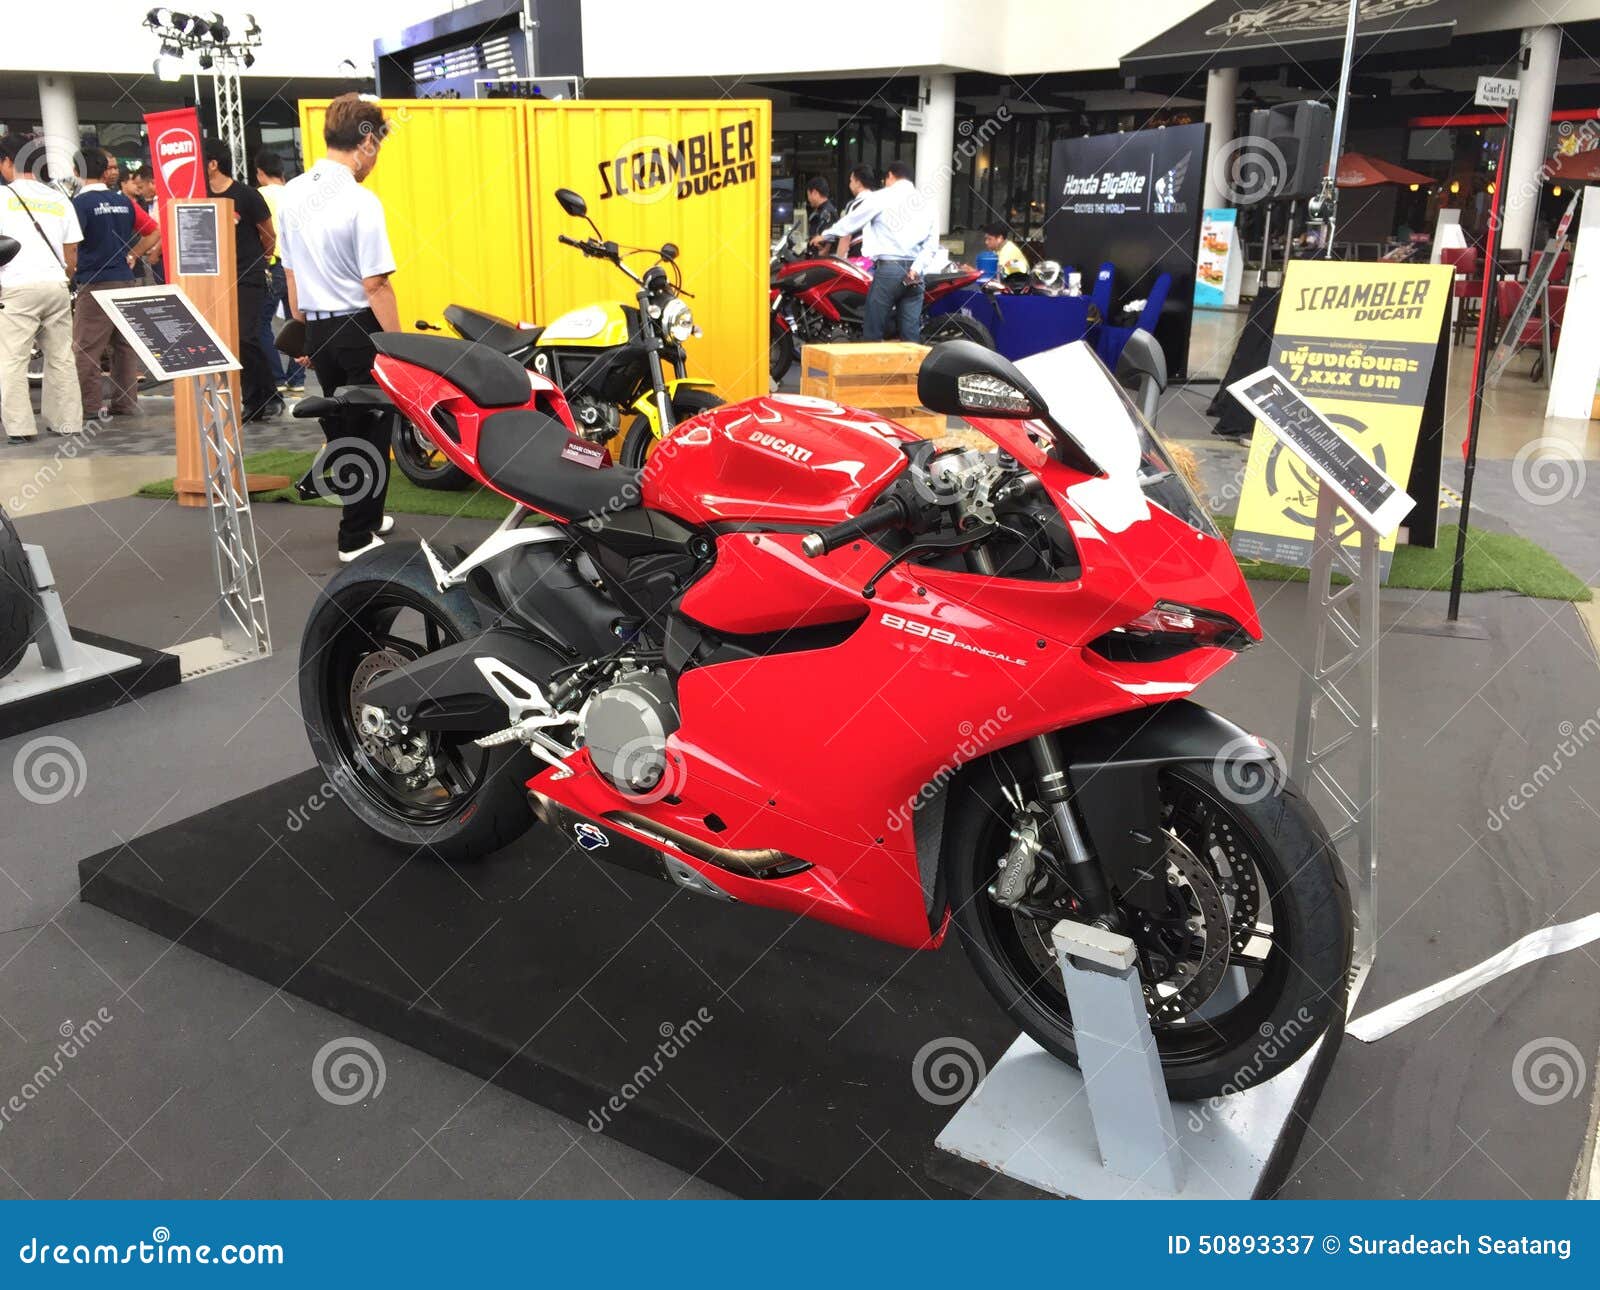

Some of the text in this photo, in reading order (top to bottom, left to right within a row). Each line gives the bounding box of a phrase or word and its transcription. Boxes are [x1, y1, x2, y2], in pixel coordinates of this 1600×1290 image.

[160, 140, 193, 156] DUCATI
[598, 120, 754, 200] SCRAMBLER
[677, 160, 756, 200] DUCATI
[1063, 171, 1146, 200] Honda BigBike
[1296, 279, 1431, 312] SCRAMBLER
[1354, 307, 1423, 322] DUCATI
[1280, 346, 1420, 373] เพียงเดือนละ
[1359, 373, 1402, 390] บาท
[748, 430, 814, 463] DUCATI
[880, 613, 957, 645] 899
